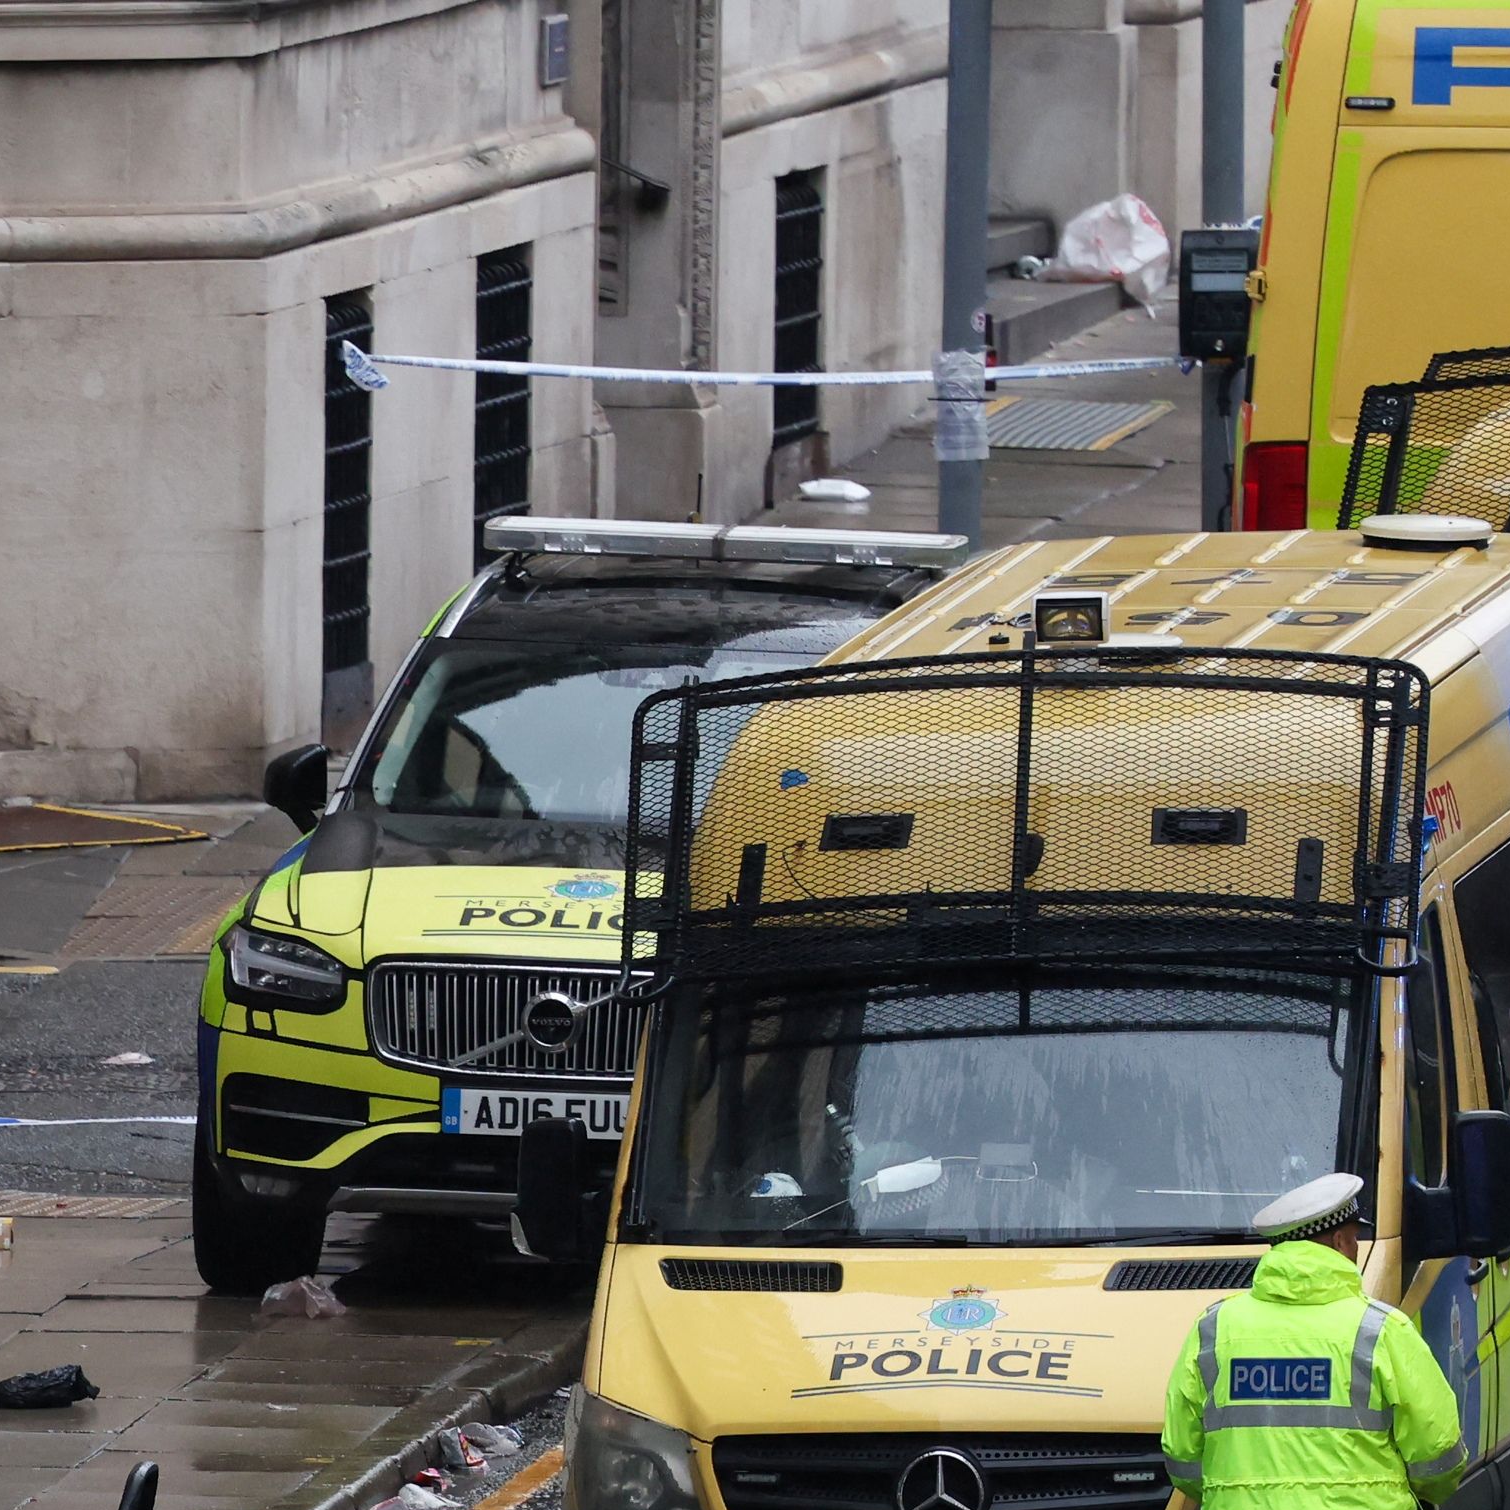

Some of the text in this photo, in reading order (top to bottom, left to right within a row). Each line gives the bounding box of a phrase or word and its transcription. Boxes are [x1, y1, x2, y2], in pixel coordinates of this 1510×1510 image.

[465, 899, 623, 911] MERSEYS
[531, 1017, 572, 1027] VOLVO
[445, 1115, 458, 1126] GB
[835, 1336, 1076, 1351] MERSEYSIDE
[829, 1348, 1072, 1381] POLICE
[1233, 1364, 1326, 1393] POLICE
